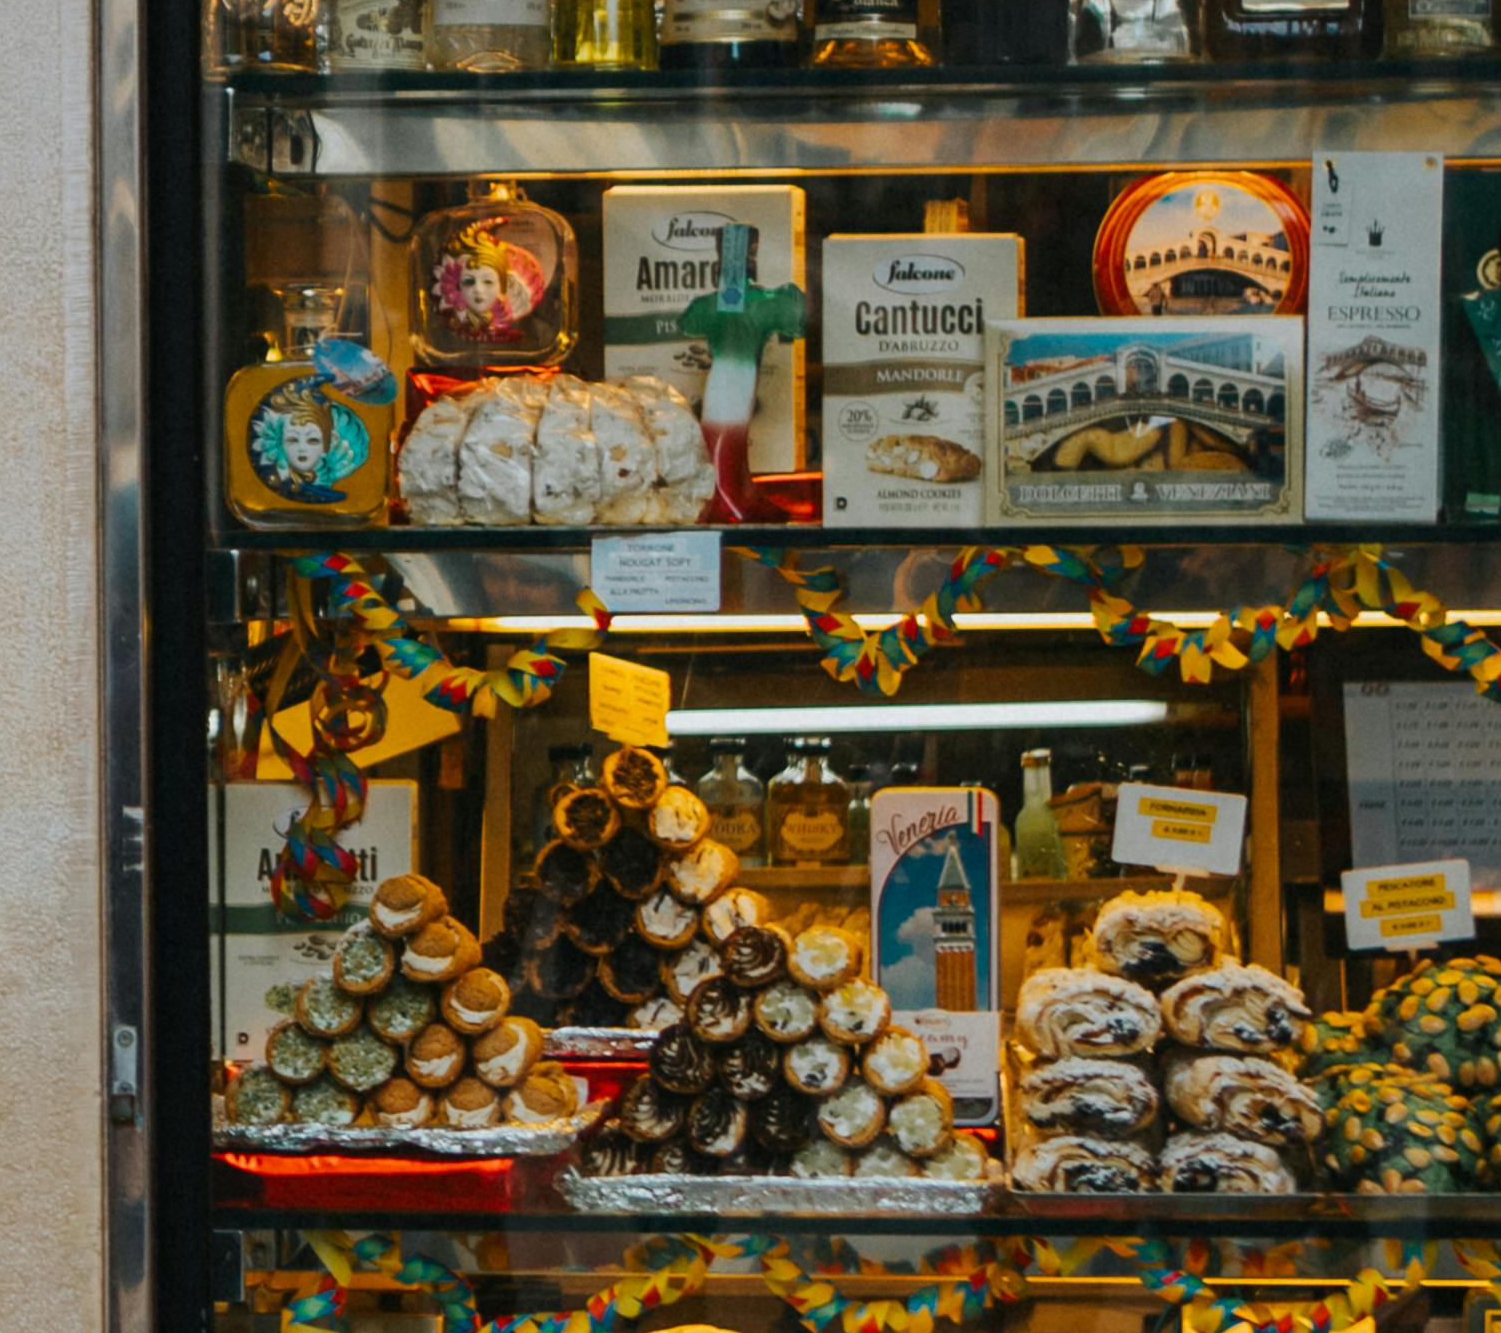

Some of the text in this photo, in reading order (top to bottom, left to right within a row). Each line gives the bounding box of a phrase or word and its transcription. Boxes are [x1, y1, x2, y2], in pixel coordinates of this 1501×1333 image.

[666, 213, 720, 242] falco
[636, 255, 721, 292] Amare
[887, 259, 957, 284] falcone
[854, 297, 984, 337] Cantucci
[1326, 304, 1422, 323] ESPRESSO
[878, 339, 960, 354] D'ABRUZZO
[876, 368, 965, 384] MANDORLE
[619, 558, 662, 567] NOUGAT
[876, 804, 961, 855] Venezia
